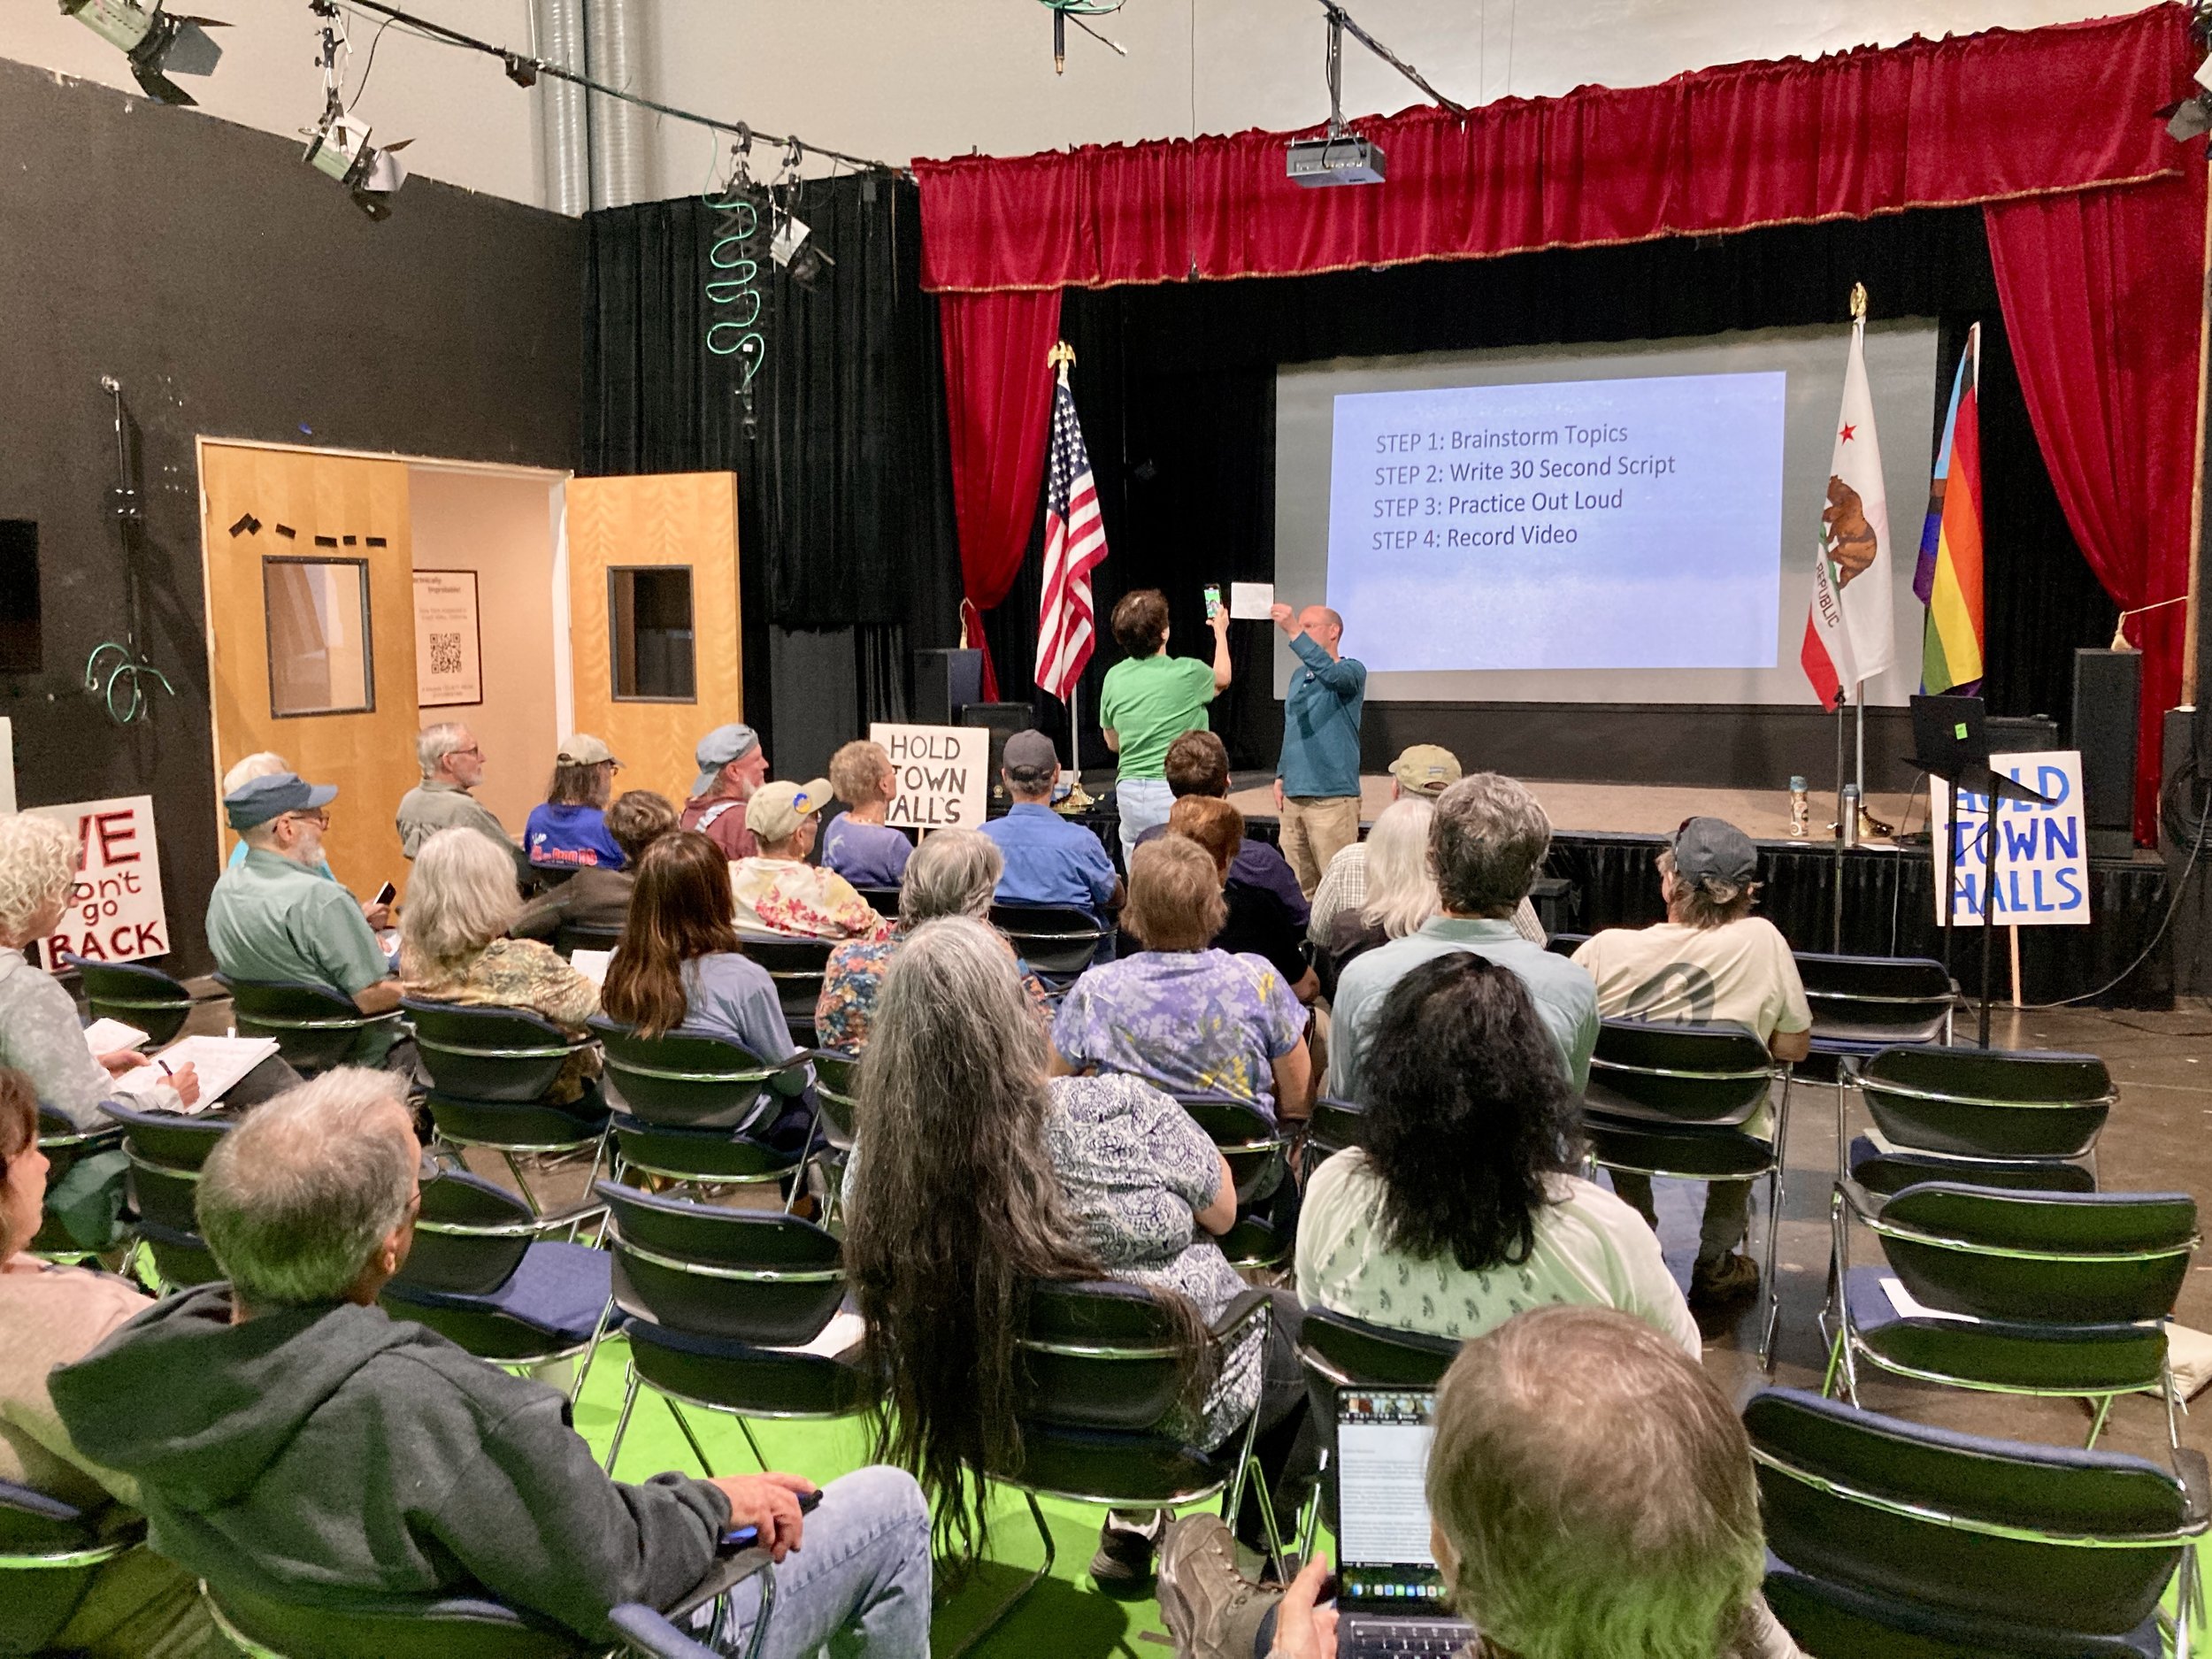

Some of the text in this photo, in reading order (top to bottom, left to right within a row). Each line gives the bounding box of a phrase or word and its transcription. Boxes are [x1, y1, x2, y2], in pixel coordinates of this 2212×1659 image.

[1375, 423, 1629, 454] STEP 1: Brainstorm Topics
[1374, 454, 1677, 486] STEP 2: Write 30 Second Script
[1373, 488, 1624, 518] STEP 3: Practice Out Loud
[1371, 524, 1578, 551] STEP 4: Record Video
[1816, 562, 1840, 628] REPUBLIC
[890, 734, 961, 760] HOLD
[78, 809, 141, 872] E
[1945, 817, 2078, 867] TOWN
[74, 872, 142, 902] on't
[82, 899, 119, 926] go
[48, 920, 165, 971] BACK
